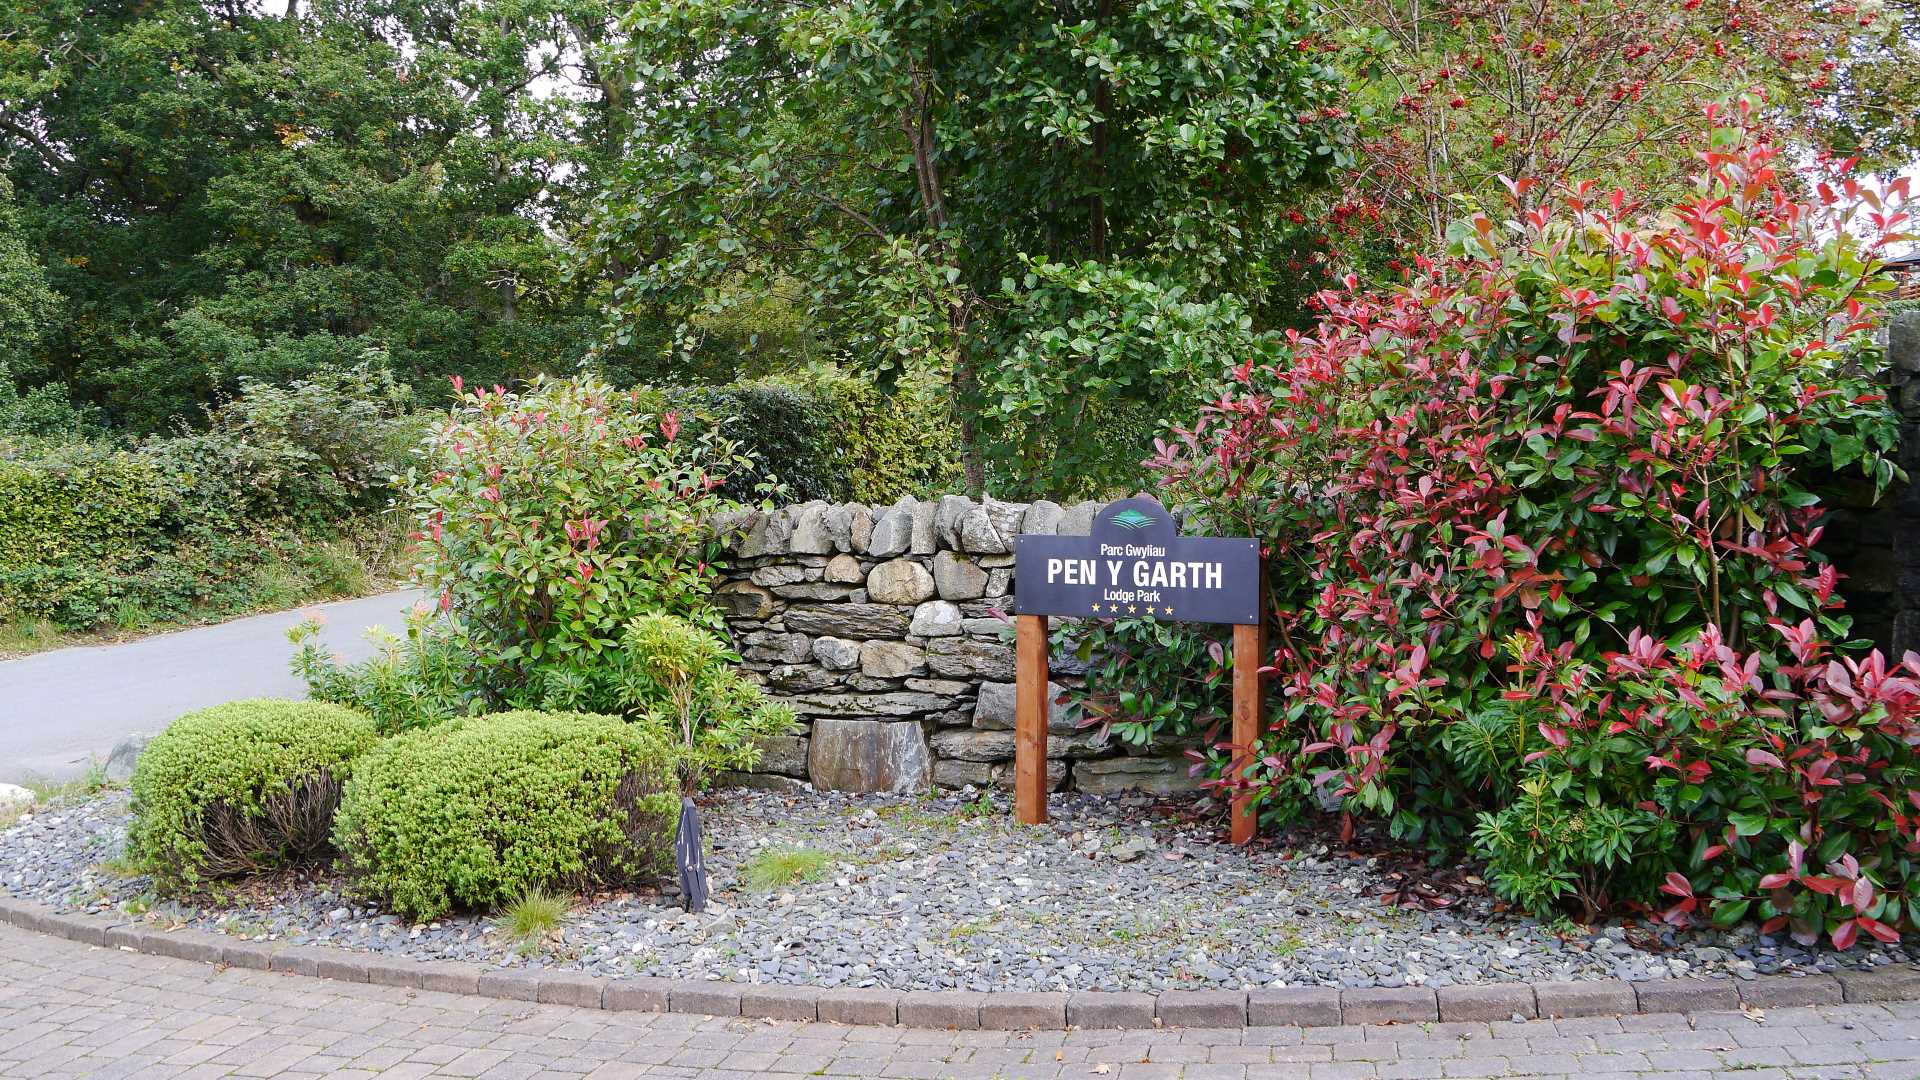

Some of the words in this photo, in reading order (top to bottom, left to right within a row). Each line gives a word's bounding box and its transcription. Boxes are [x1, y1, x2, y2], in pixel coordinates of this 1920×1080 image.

[1100, 544, 1123, 556] Parc
[1125, 544, 1166, 559] Gwyliau
[1047, 558, 1096, 585] PEN
[1107, 560, 1123, 586] Y
[1133, 560, 1222, 589] GARTH
[1104, 588, 1135, 604] Lodge
[1137, 590, 1160, 603] Park
